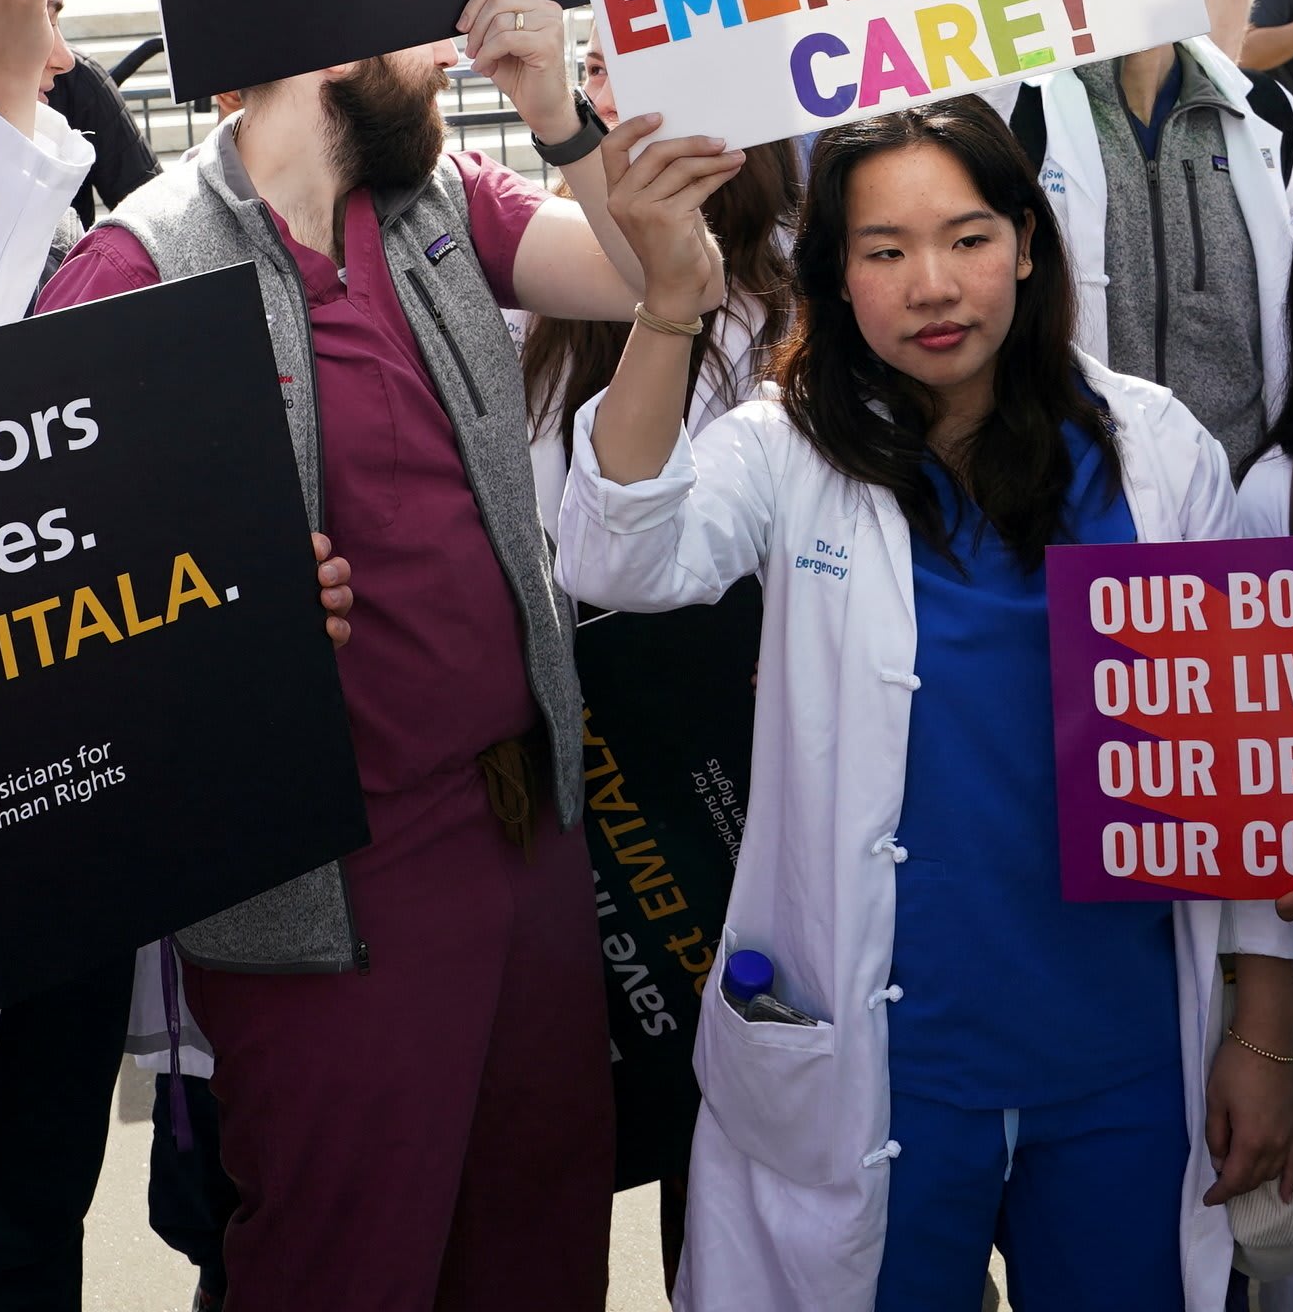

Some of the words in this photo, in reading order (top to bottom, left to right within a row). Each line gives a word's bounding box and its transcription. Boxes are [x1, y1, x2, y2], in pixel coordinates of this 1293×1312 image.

[816, 539, 833, 556] Dr.
[835, 545, 849, 560] J.
[1089, 574, 1208, 635] OUR
[1093, 657, 1213, 717] OUR
[76, 741, 112, 769] for
[1097, 740, 1217, 798] OUR
[55, 763, 127, 807] Rights
[691, 771, 710, 794] for
[706, 758, 737, 808] Rights
[1102, 821, 1220, 877] OUR
[602, 932, 678, 1037] save
